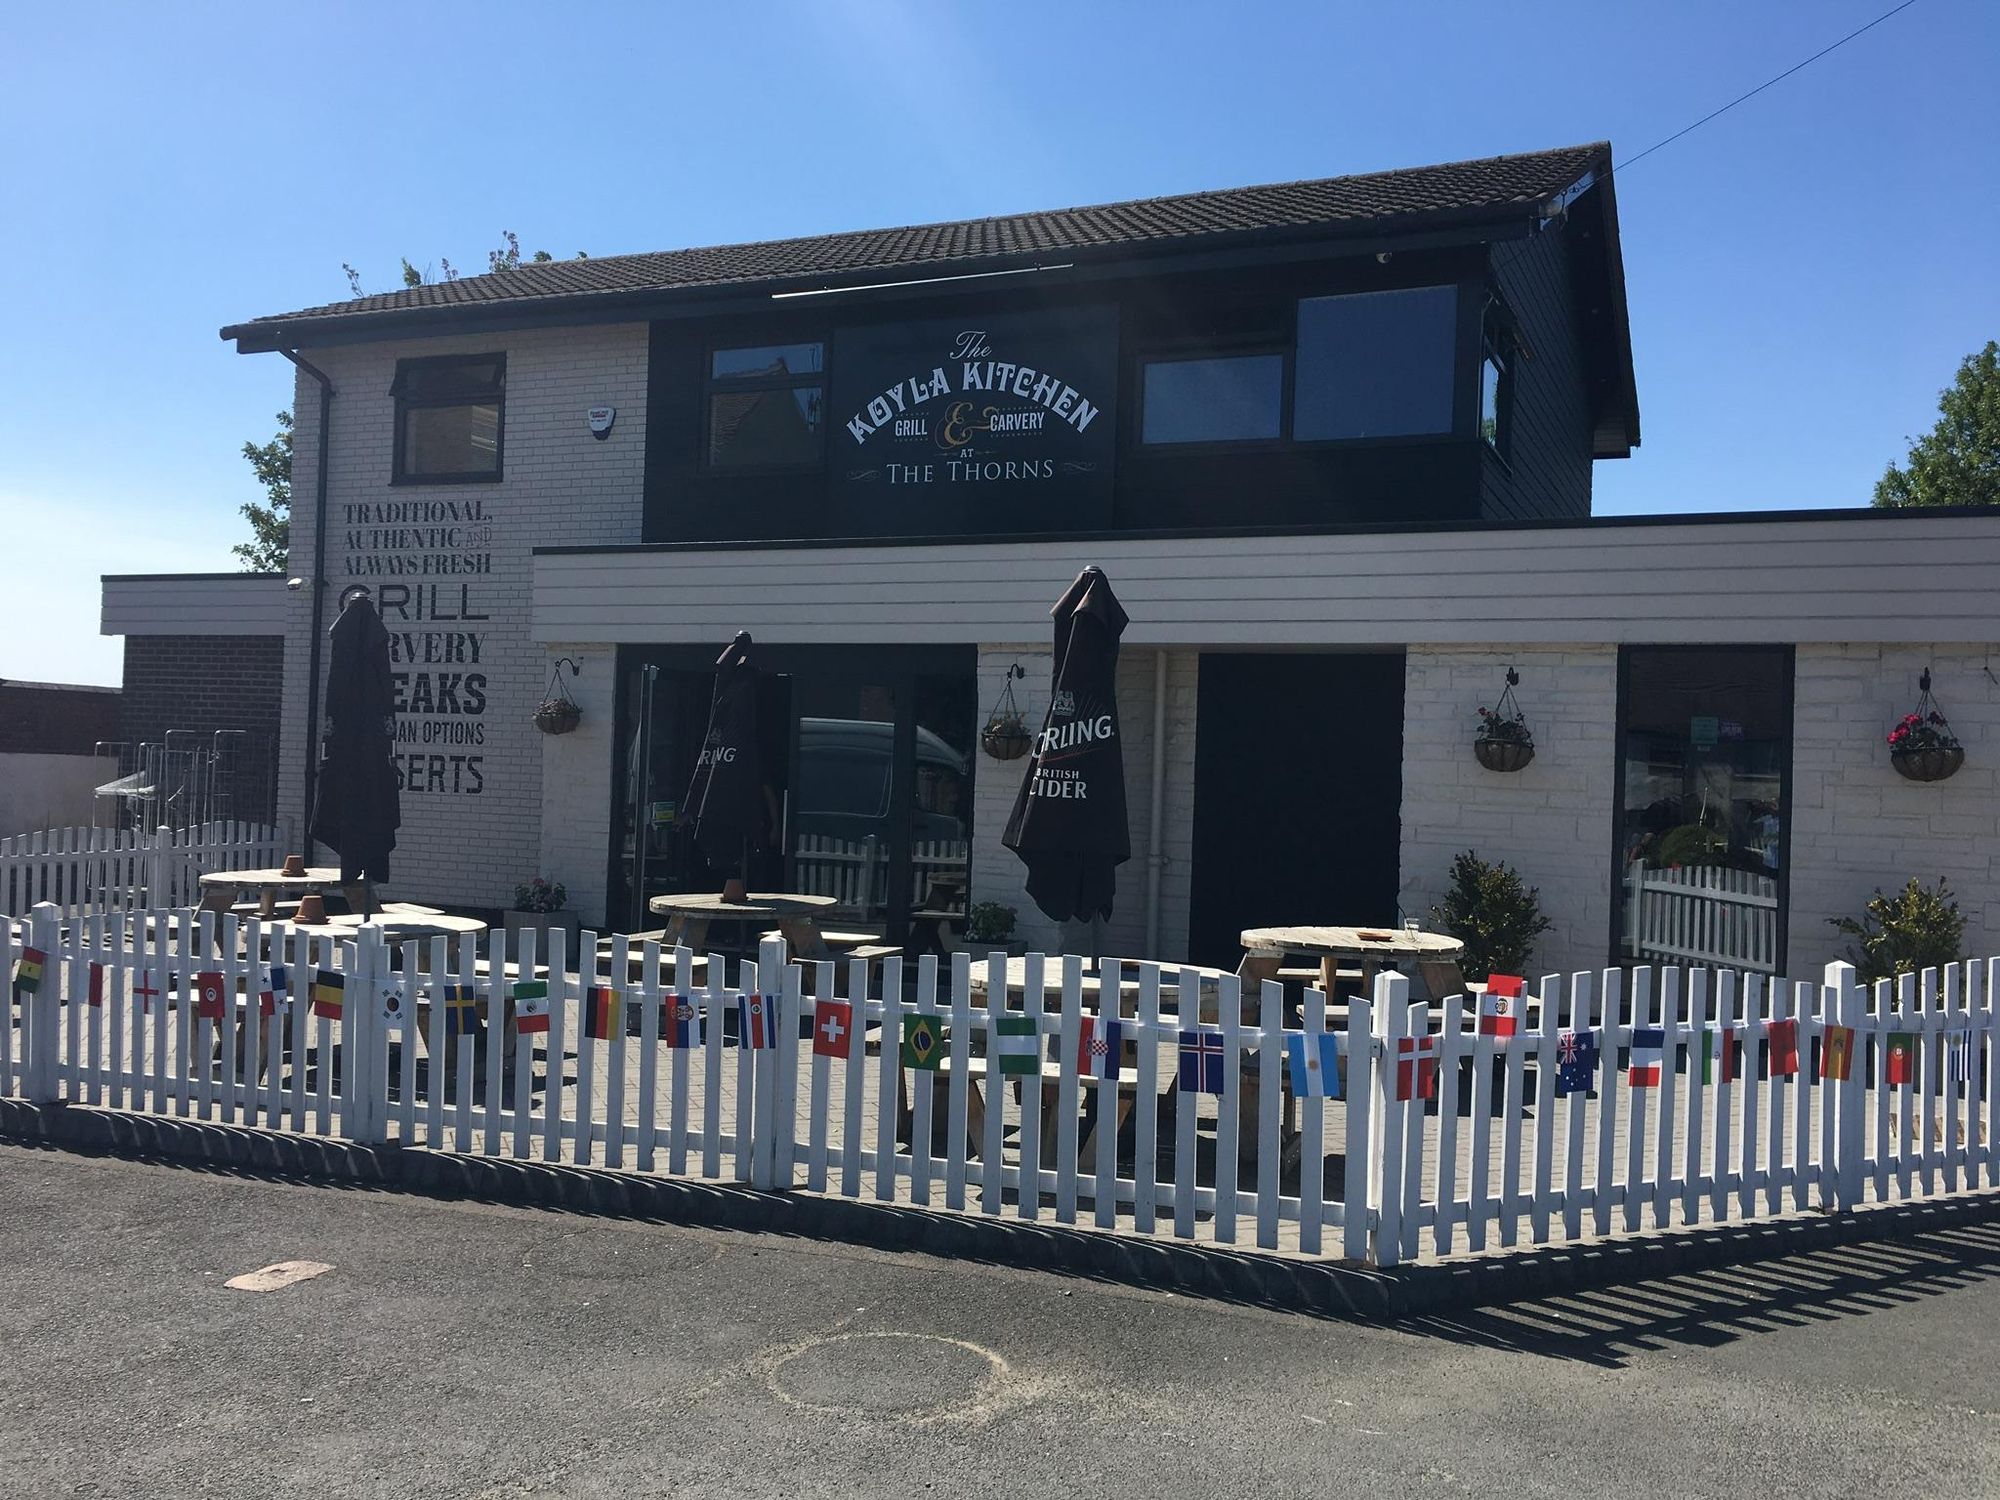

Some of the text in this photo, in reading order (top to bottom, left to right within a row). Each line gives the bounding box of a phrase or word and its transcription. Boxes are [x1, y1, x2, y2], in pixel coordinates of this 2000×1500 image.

[949, 330, 992, 360] The
[846, 361, 1099, 445] KOYLA KITCHEN
[895, 419, 928, 437] GRILL
[990, 412, 1045, 432] CARVERY
[960, 448, 974, 458] AT
[886, 459, 1054, 484] THE THORNS
[343, 526, 492, 550] AUTHENTIC AND
[344, 553, 491, 576] ALWAYS FRESH
[388, 632, 488, 664] RVERY
[392, 672, 488, 715] EAKS
[422, 722, 486, 745] OPTIONS
[1036, 768, 1080, 780] BRITISH
